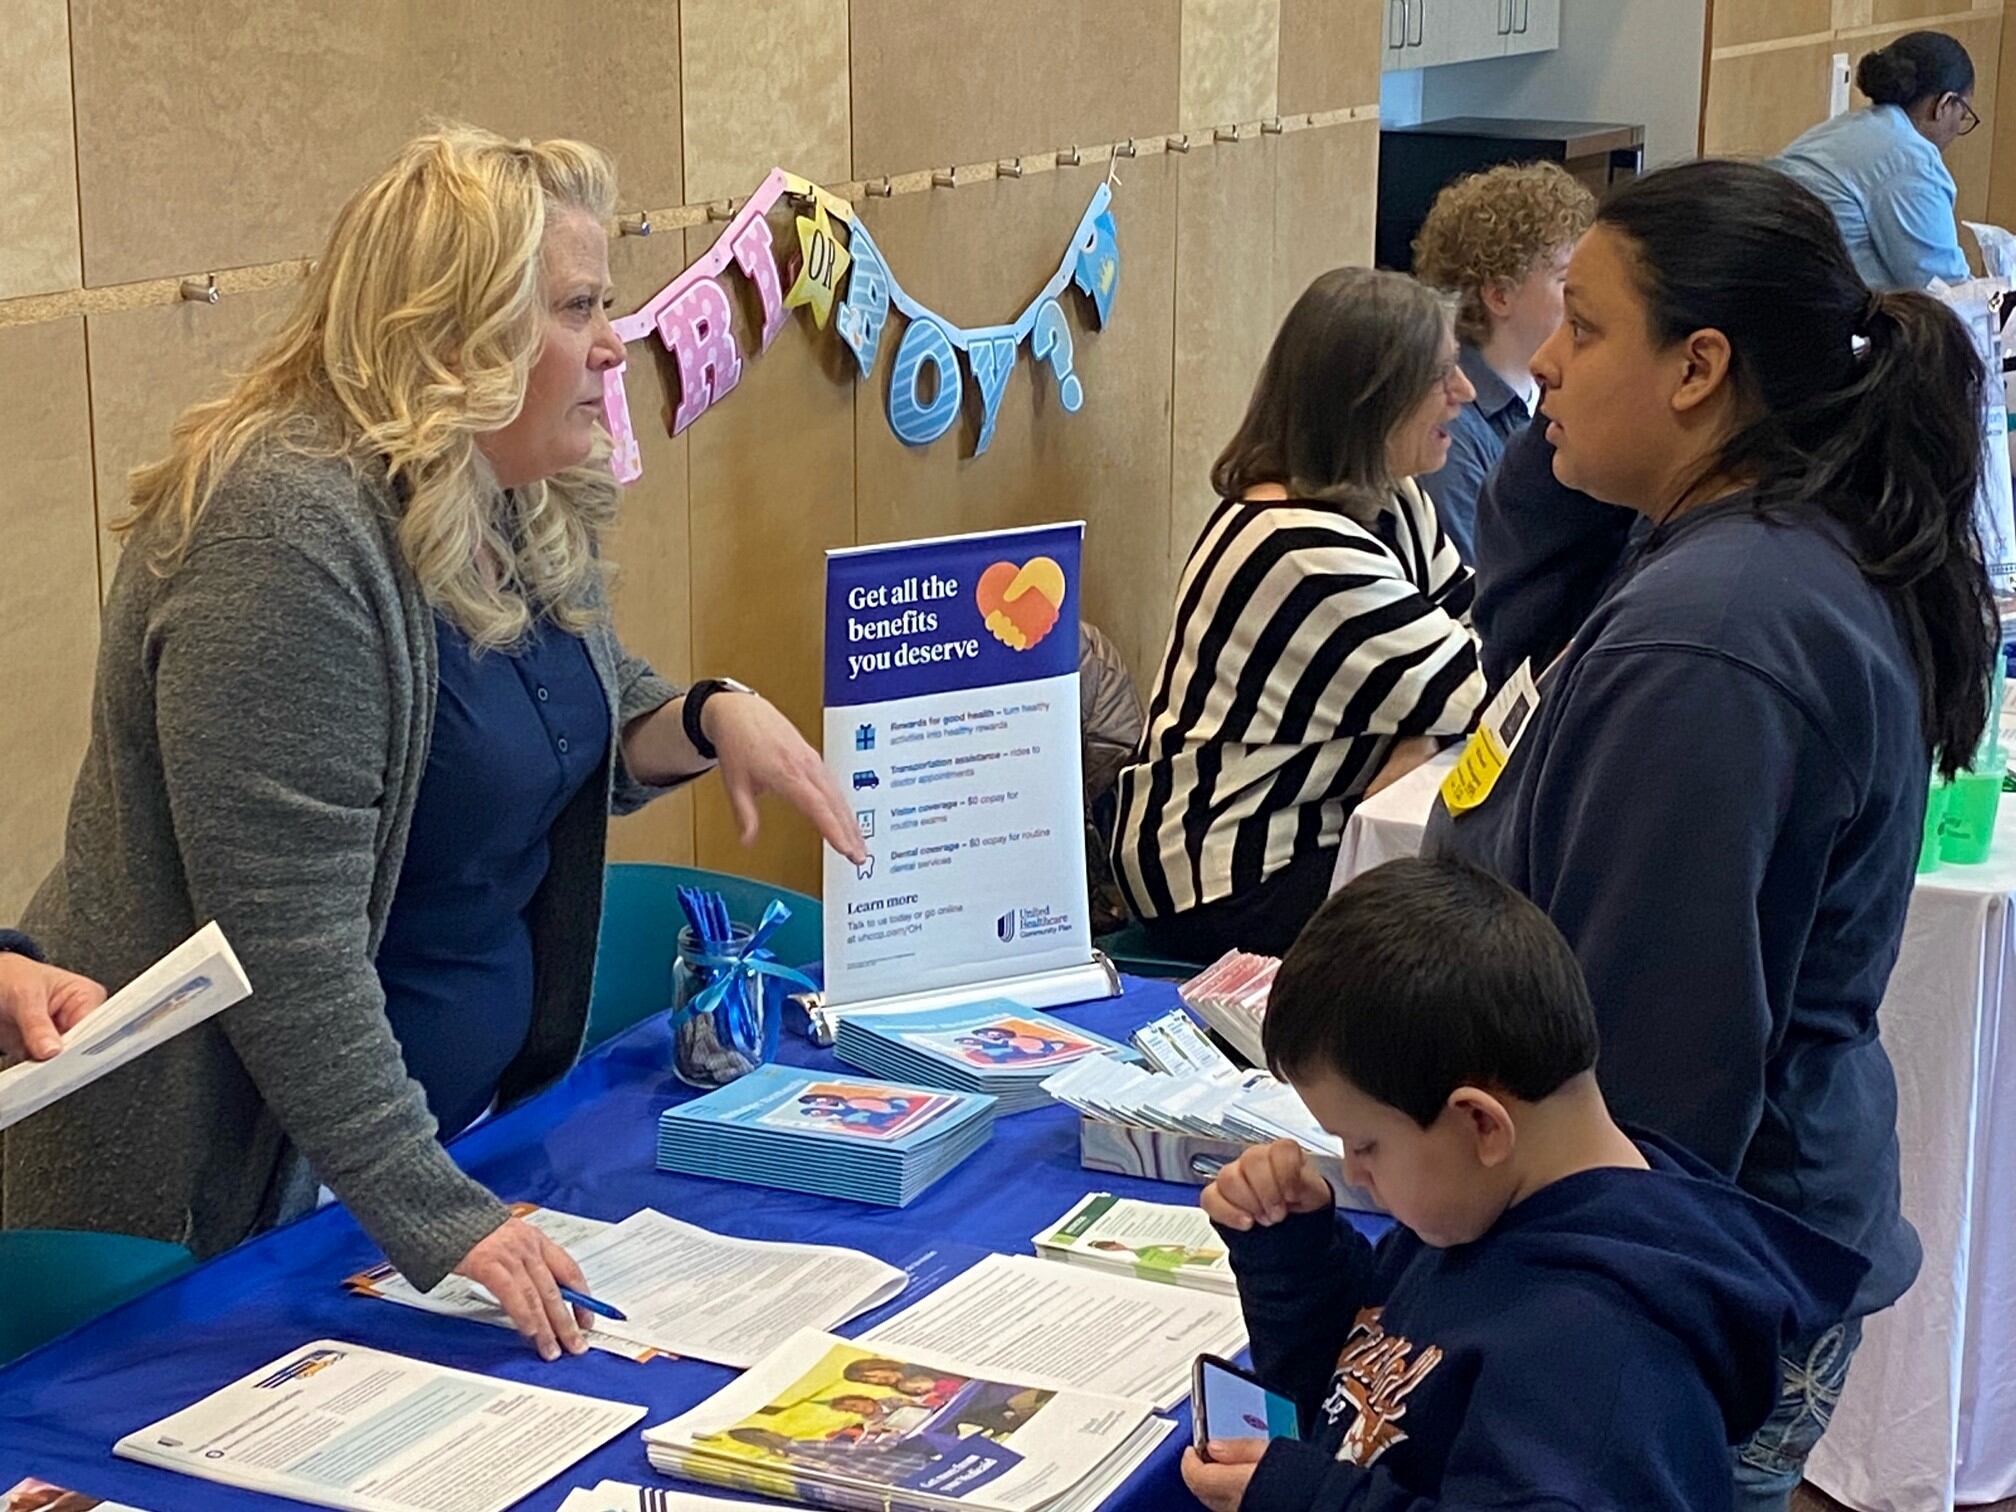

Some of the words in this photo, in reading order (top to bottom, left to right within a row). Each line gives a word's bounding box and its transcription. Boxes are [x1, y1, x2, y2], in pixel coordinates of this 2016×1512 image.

[807, 228, 837, 291] OR
[836, 228, 1085, 459] BOY?
[848, 585, 888, 610] Get
[891, 577, 918, 604] all
[921, 575, 958, 600] the
[848, 610, 938, 641] benefits
[848, 651, 891, 679] you
[894, 639, 979, 667] deserve
[891, 718, 927, 730] Rewards
[943, 713, 965, 724] good
[968, 709, 994, 720] health
[927, 730, 942, 738] into
[944, 726, 973, 736] healthy
[976, 721, 1007, 732] rewards
[891, 758, 952, 774] Transportation
[955, 752, 1000, 764] assistance
[1011, 747, 1030, 756] rides
[918, 769, 975, 783] appointments
[891, 807, 916, 816] Vision
[918, 801, 958, 813] coverage
[968, 796, 978, 805] $0
[981, 794, 1005, 804] copay
[1007, 791, 1018, 799] for
[920, 816, 947, 826] exams
[891, 848, 918, 860] Dental
[920, 843, 959, 855] coverage
[969, 838, 980, 847] $0
[983, 835, 1007, 846] copay
[1009, 833, 1020, 841] for
[1022, 829, 1050, 839] routine
[918, 857, 951, 869] services
[848, 900, 884, 914] Learn
[887, 894, 918, 908] more
[1020, 905, 1049, 919] United
[848, 921, 864, 930] Talk
[889, 914, 912, 923] today
[925, 909, 936, 919] go
[938, 905, 963, 915] online
[1020, 915, 1067, 928] Healthcare
[847, 936, 856, 944] at
[1020, 927, 1056, 938] Community
